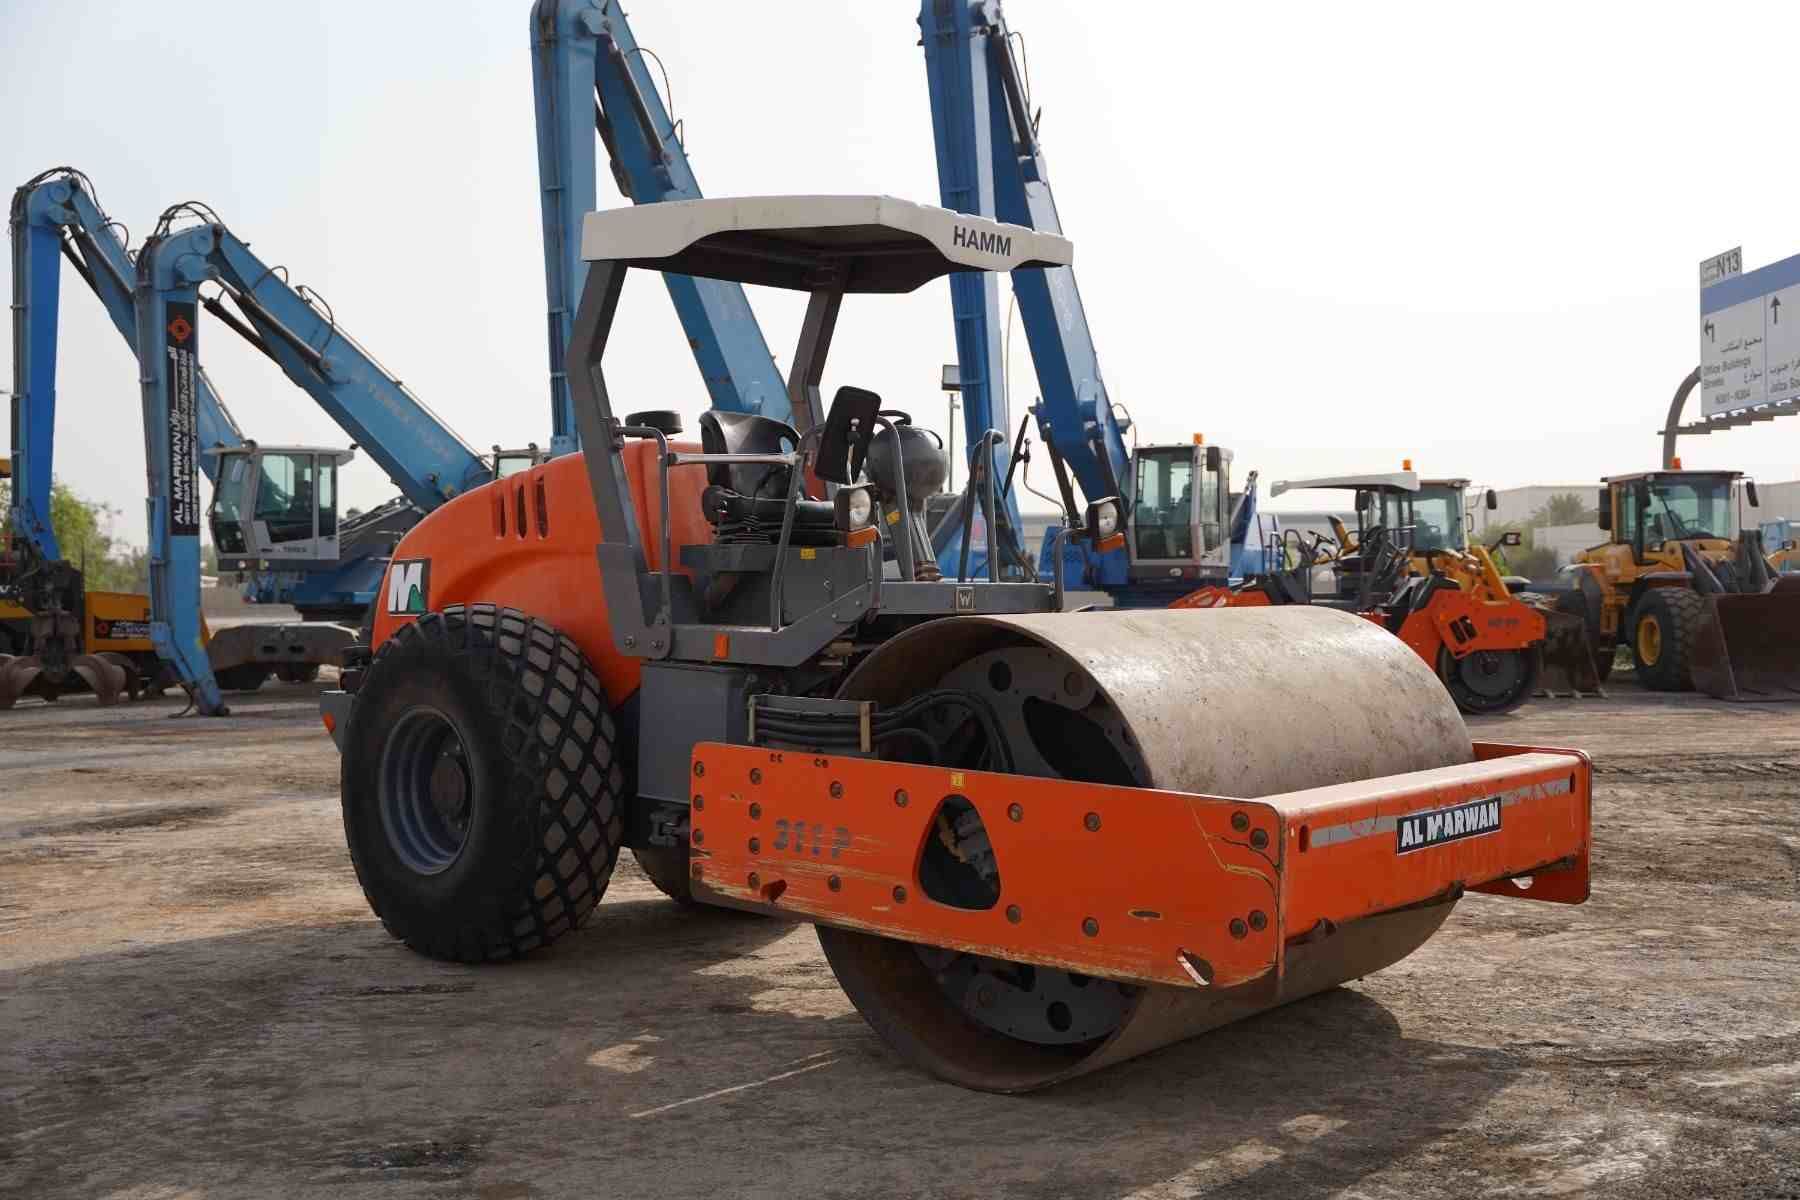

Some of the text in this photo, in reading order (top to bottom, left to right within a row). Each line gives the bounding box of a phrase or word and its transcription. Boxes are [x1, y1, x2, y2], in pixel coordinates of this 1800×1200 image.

[953, 224, 1012, 257] HAMM
[1717, 252, 1739, 275] N13
[171, 431, 184, 525] AL MARWAN
[1401, 801, 1500, 848] AL MARWAN
